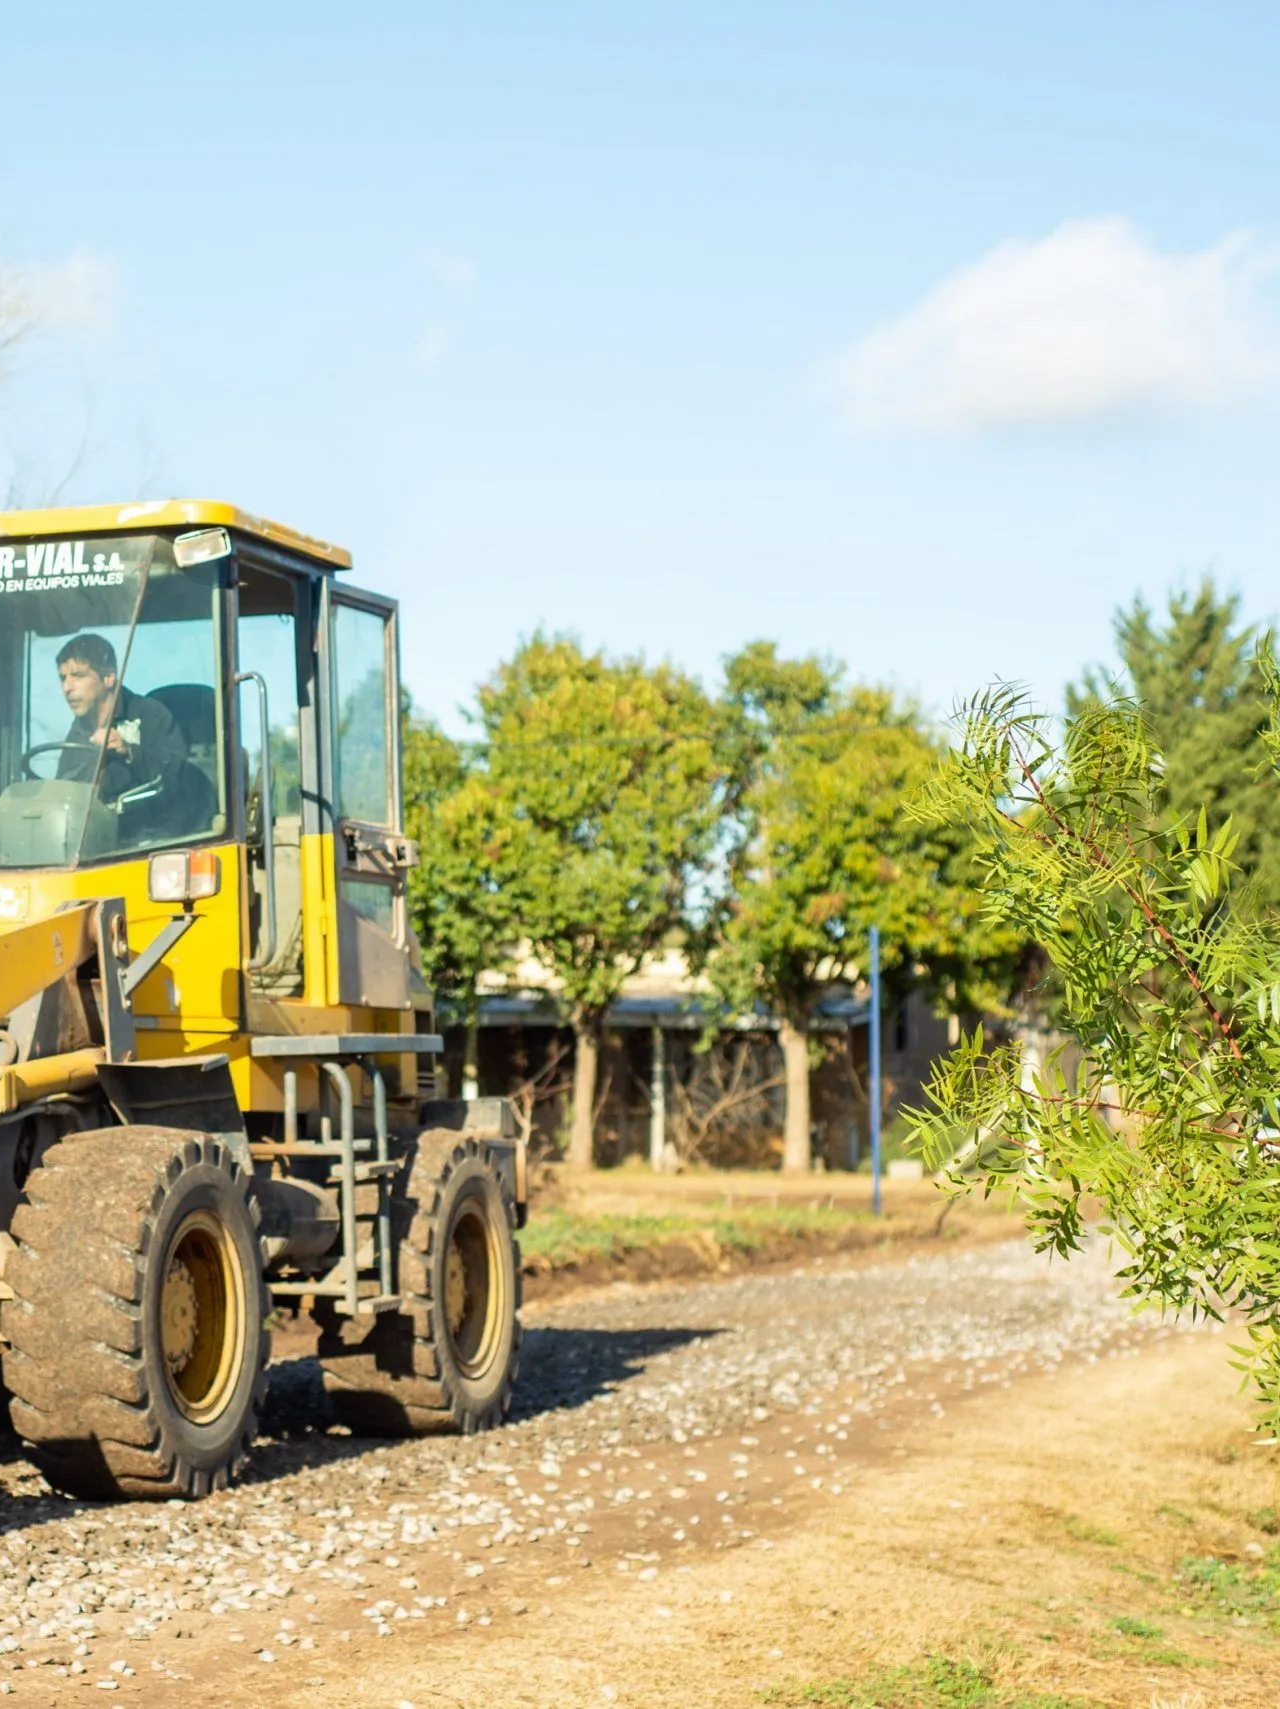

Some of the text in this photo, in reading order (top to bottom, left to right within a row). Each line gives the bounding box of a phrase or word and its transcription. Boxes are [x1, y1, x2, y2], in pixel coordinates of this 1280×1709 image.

[92, 552, 124, 572] S.A.
[6, 579, 24, 592] EN
[25, 575, 79, 591] EQUIPOS
[81, 572, 124, 587] VIALES
